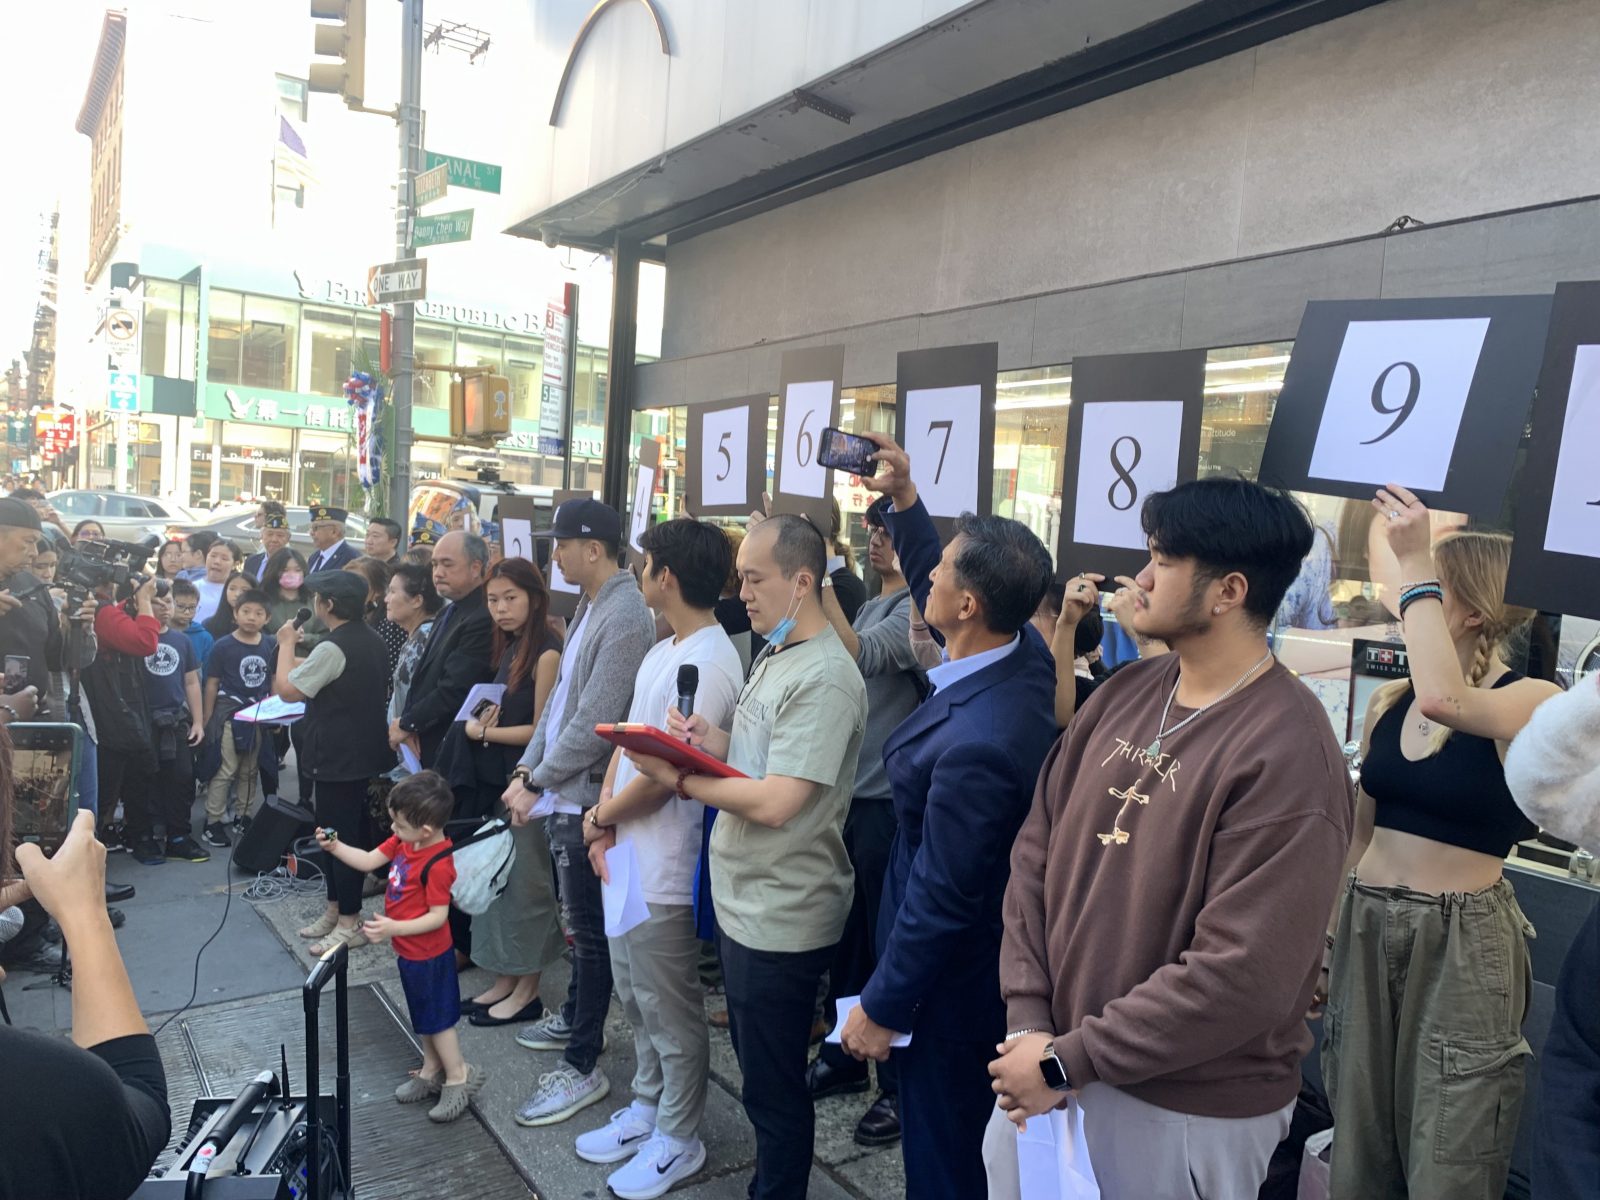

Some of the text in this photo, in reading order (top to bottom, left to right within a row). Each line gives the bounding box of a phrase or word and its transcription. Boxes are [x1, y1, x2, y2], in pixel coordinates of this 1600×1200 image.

[436, 221, 453, 235] Chen
[455, 219, 471, 235] Way
[373, 271, 419, 293] ONE WAY
[1359, 361, 1422, 446] 9
[716, 431, 732, 481] 5
[796, 409, 815, 468] 6
[926, 420, 954, 485] 7
[1107, 436, 1142, 511] 8
[1365, 663, 1389, 672] SWISS
